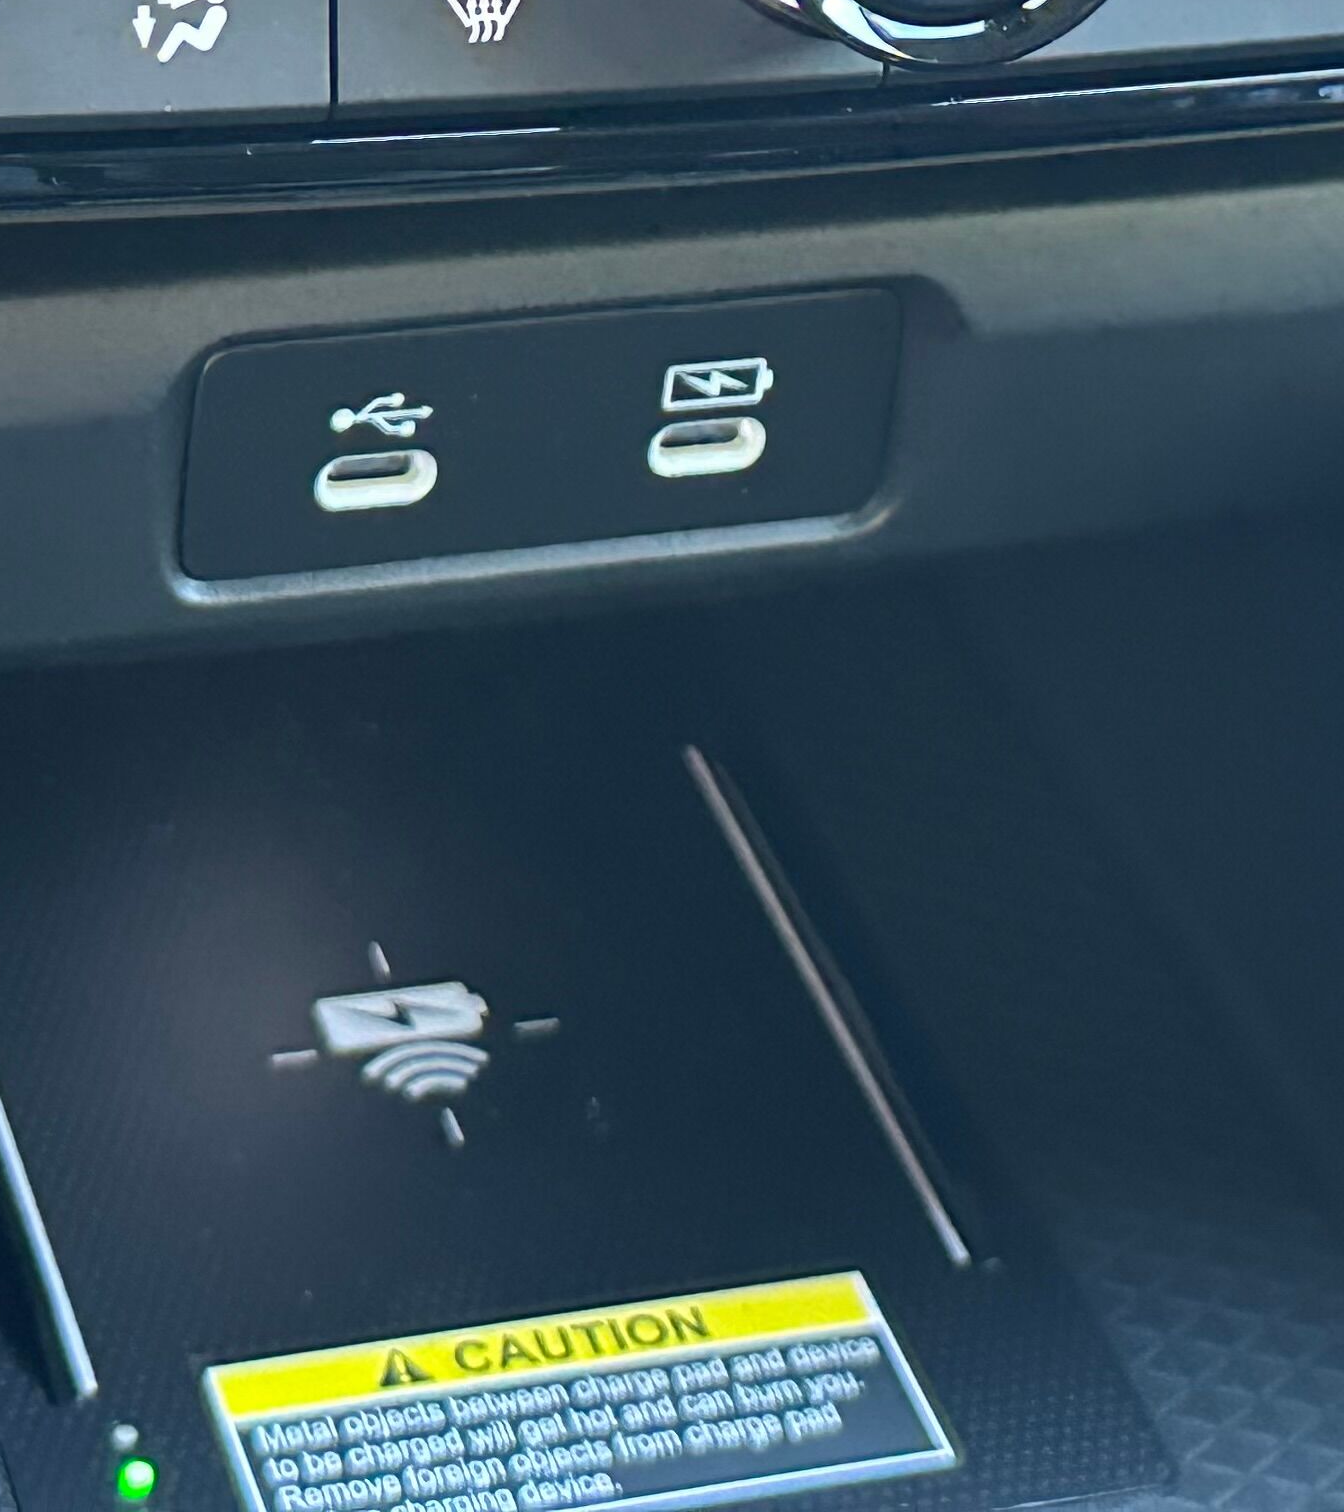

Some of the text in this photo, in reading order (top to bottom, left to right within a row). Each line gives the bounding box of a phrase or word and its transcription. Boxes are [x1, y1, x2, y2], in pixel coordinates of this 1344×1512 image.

[455, 1306, 711, 1373] CAUTION
[255, 1337, 880, 1454] Metal objects between charge pad and device
[263, 1370, 865, 1487] to be charged will get hot and can burn you.
[274, 1401, 842, 1512] Remove foreign objects from charge pad
[517, 1472, 623, 1508] device.
